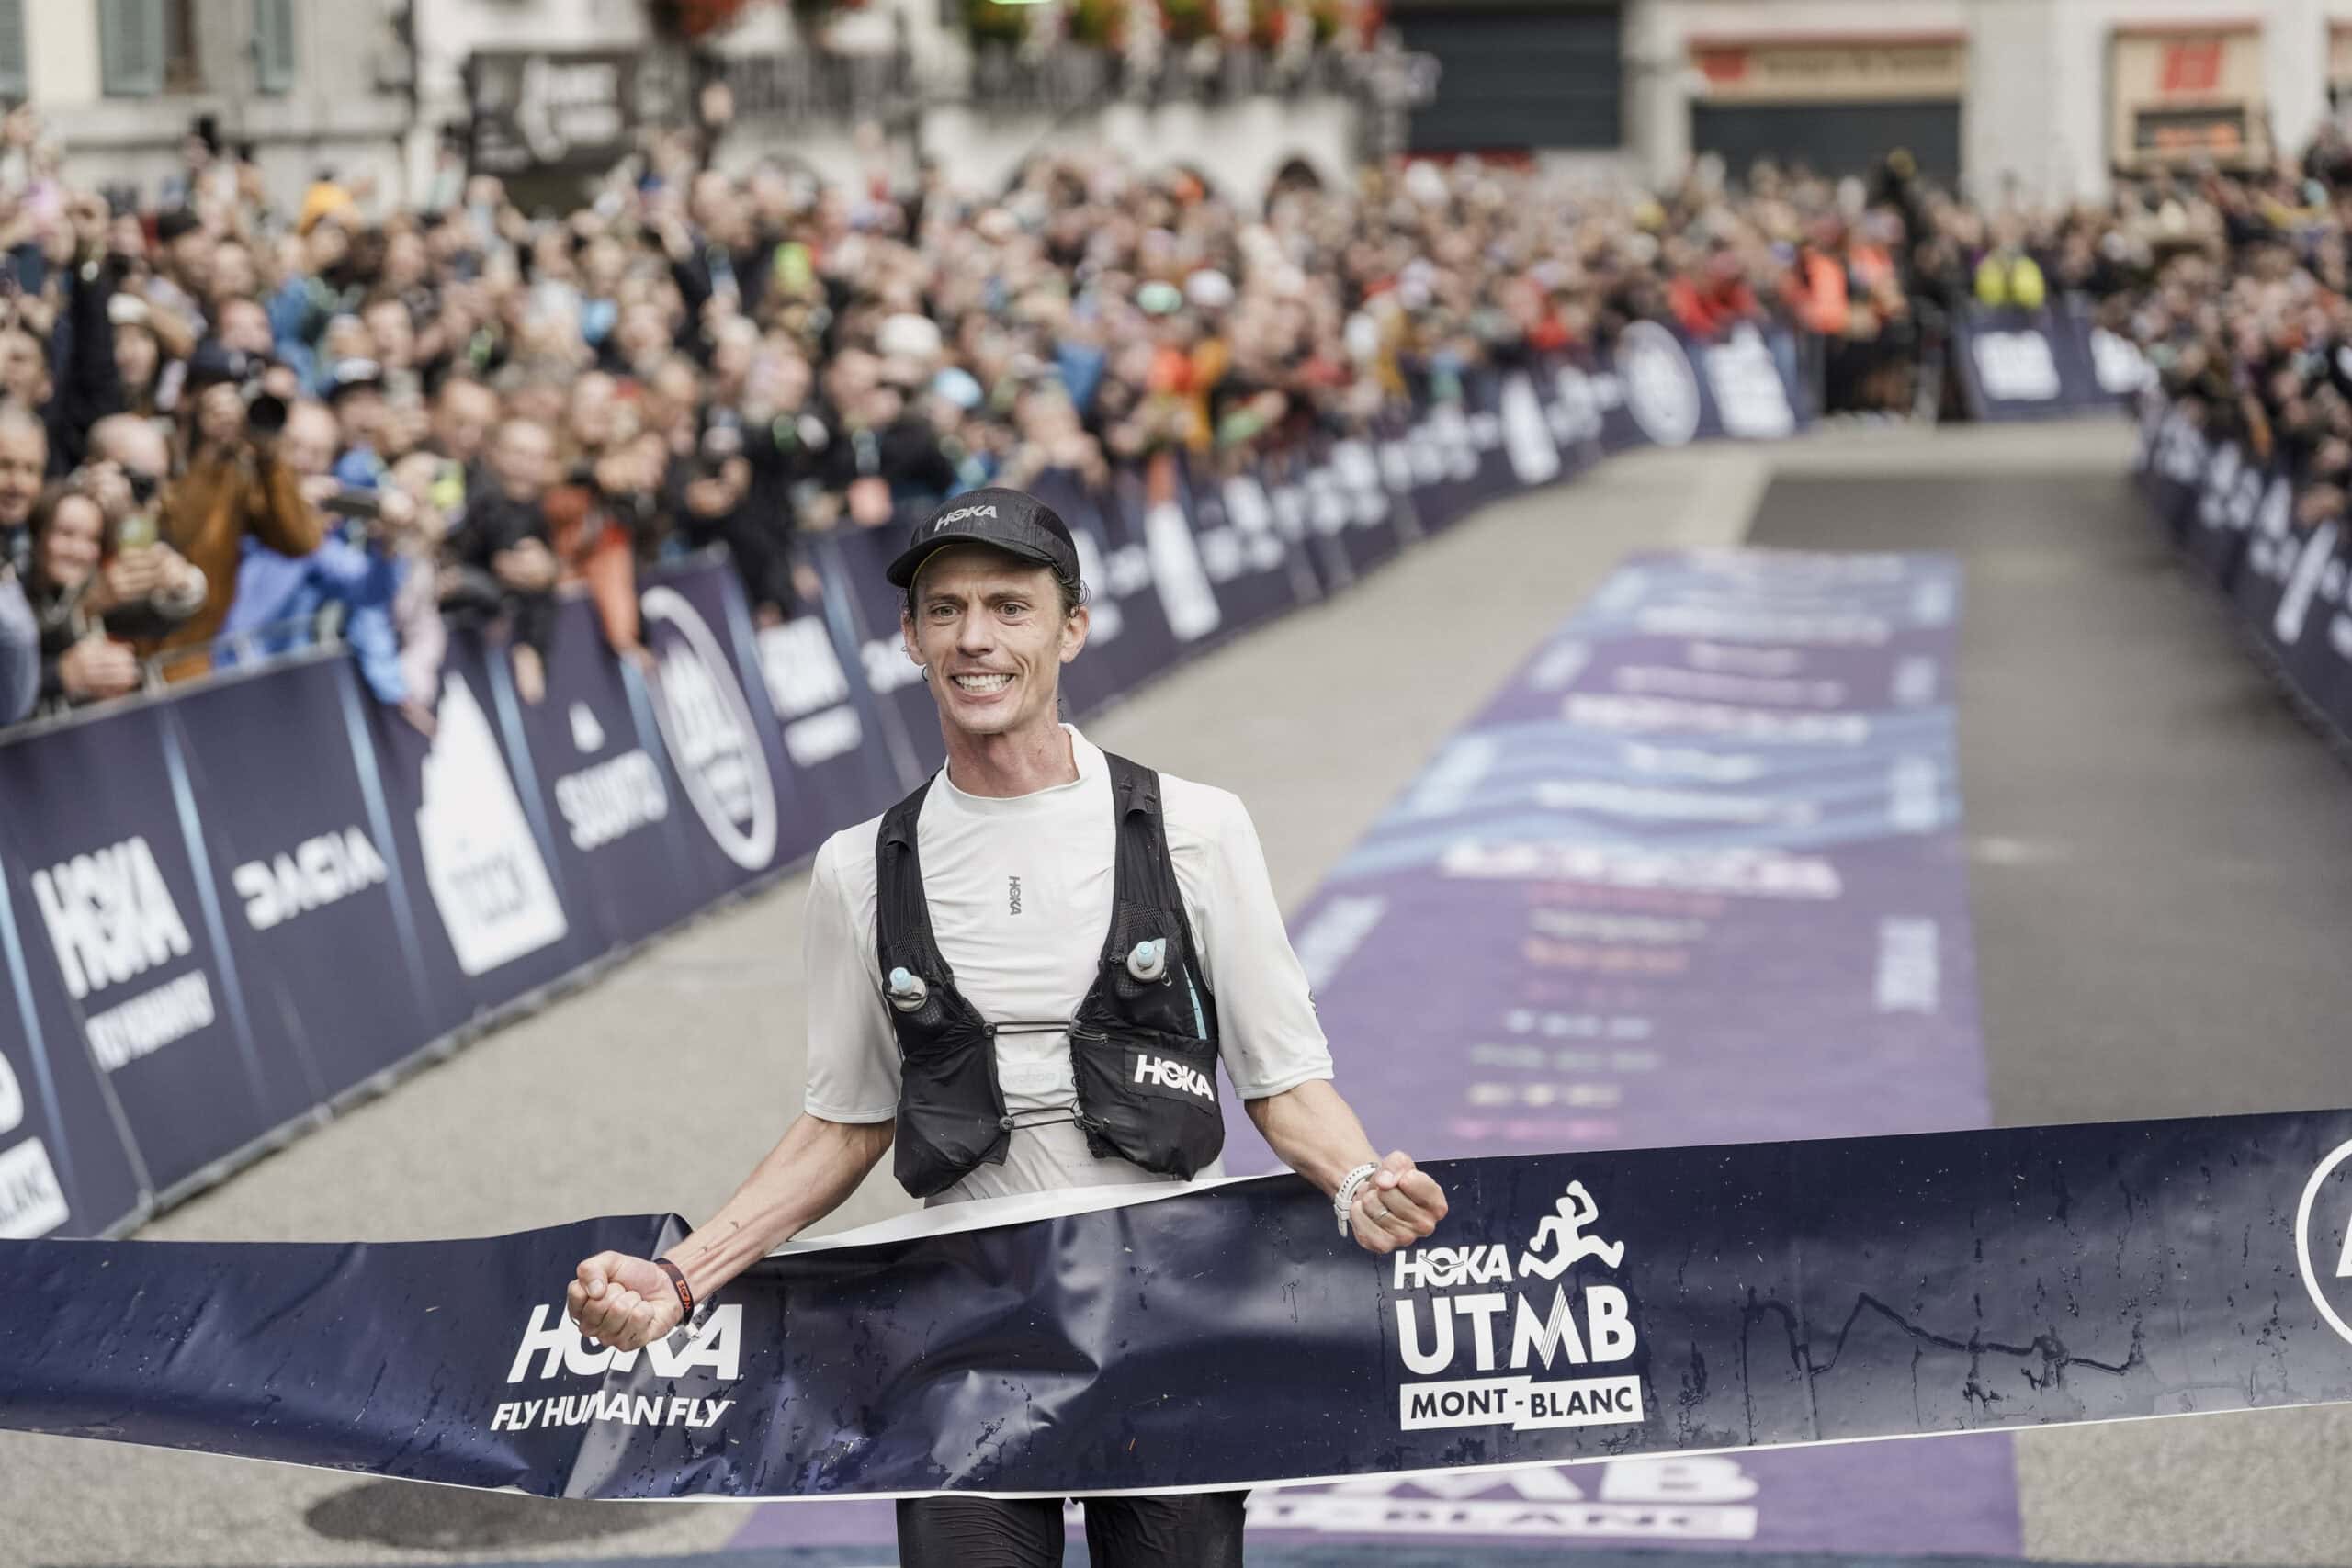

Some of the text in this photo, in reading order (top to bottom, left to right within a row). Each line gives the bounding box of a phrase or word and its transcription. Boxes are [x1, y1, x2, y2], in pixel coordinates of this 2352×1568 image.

[933, 505, 998, 533] HOKA
[1008, 875, 1022, 916] HOKA
[1134, 1054, 1215, 1102] HOKA
[1393, 1243, 1513, 1290] HOKA
[1395, 1283, 1638, 1375] UTMB
[490, 1398, 544, 1431] FLY
[665, 1397, 734, 1427] FLY
